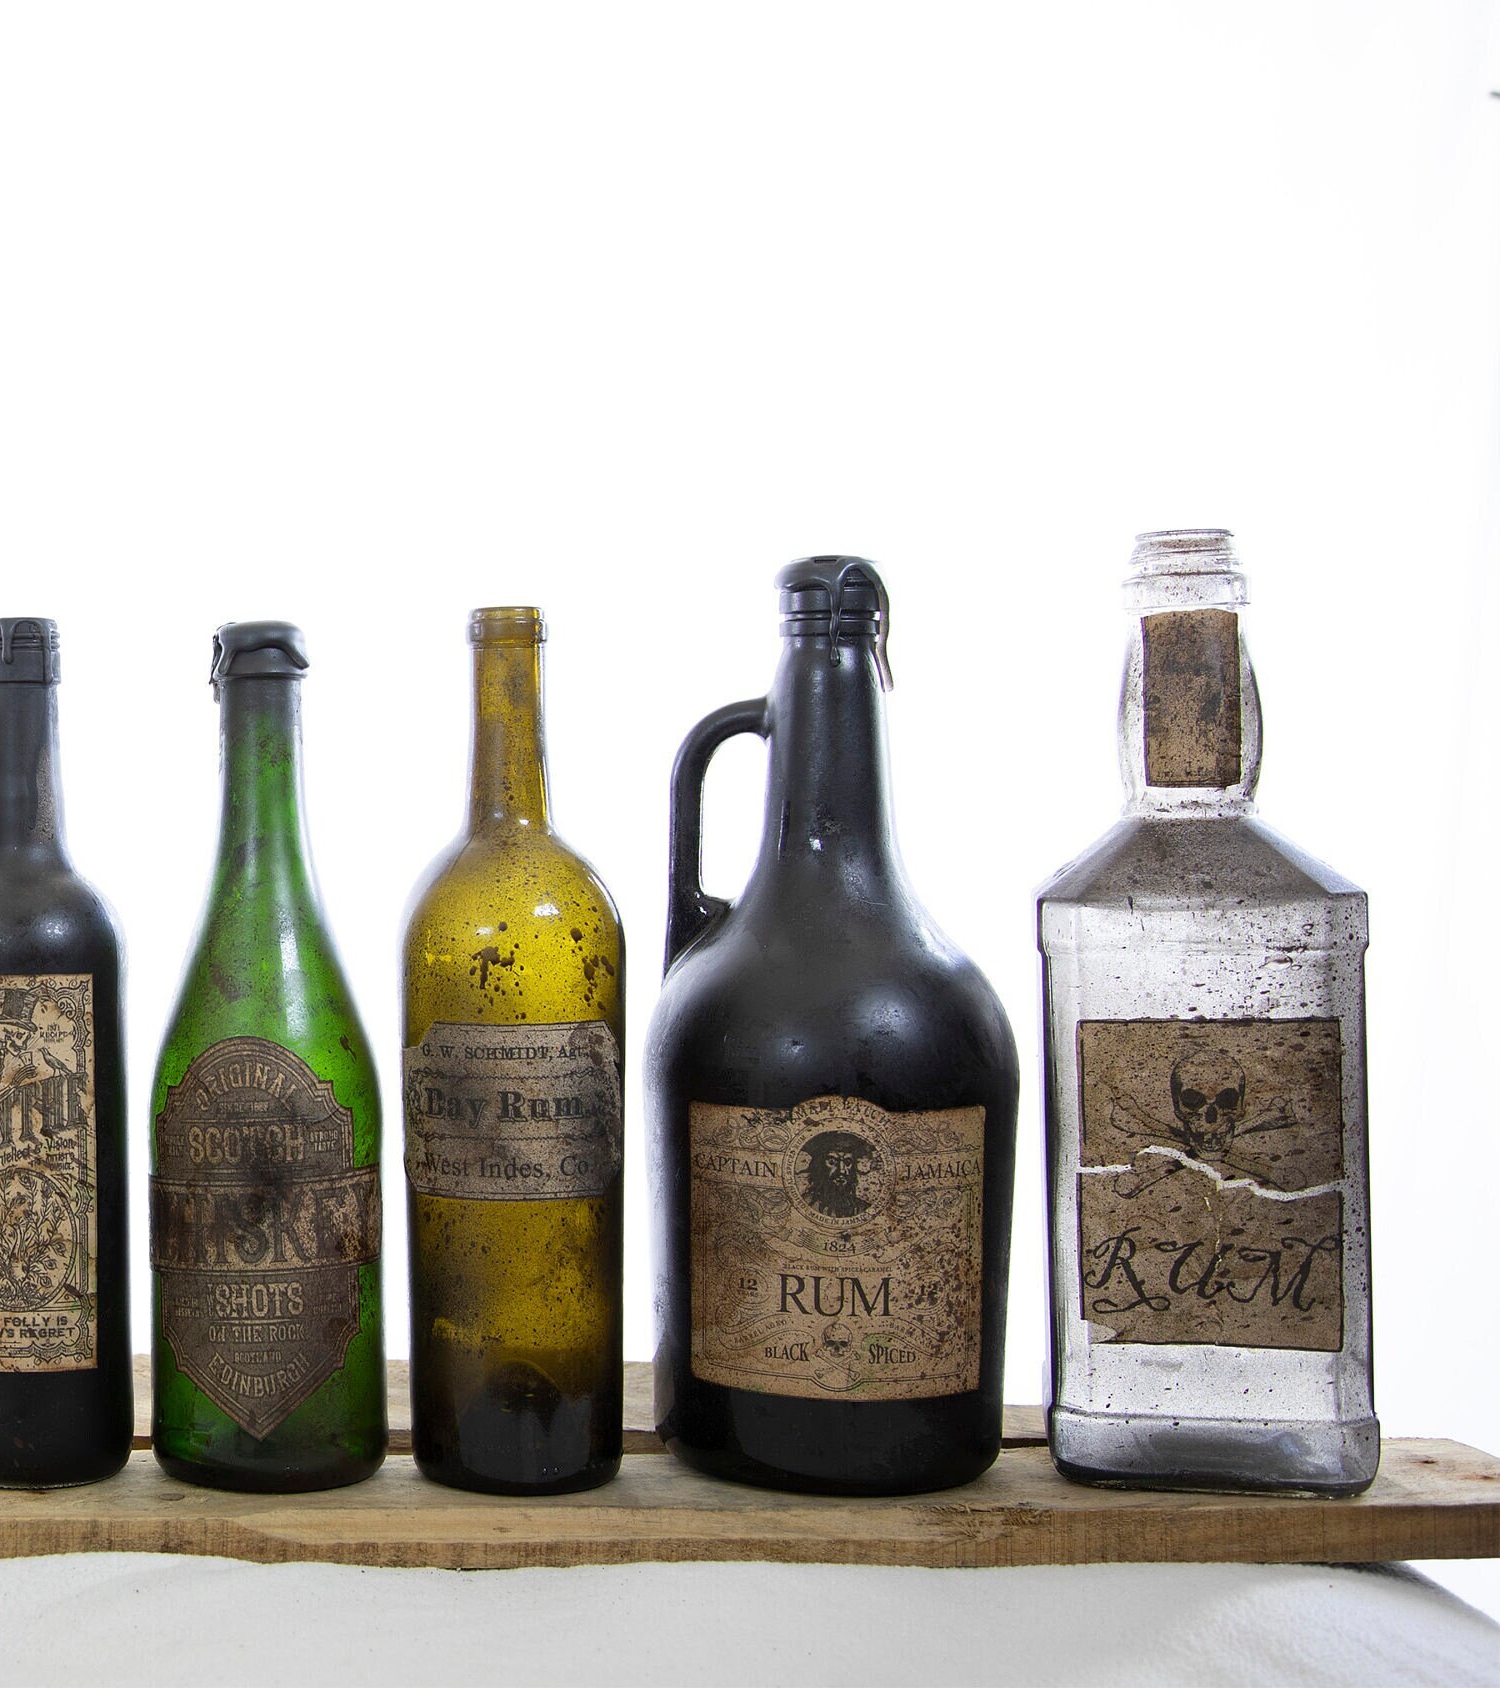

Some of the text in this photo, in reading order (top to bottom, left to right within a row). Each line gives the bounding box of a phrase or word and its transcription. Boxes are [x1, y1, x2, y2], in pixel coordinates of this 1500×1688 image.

[465, 1046, 553, 1061] SCHMIDT,
[195, 1061, 298, 1112] ORIGINAL
[425, 1087, 487, 1129] Bay
[188, 1124, 306, 1164] SCOTCH
[424, 1153, 470, 1176] West
[479, 1157, 551, 1179] Indes,
[694, 1154, 981, 1181] CAPTAIN JAMAICA
[830, 1217, 839, 1225] IN
[823, 1241, 856, 1254] 1824
[739, 1278, 758, 1291] 12
[777, 1273, 896, 1317] RUM
[216, 1282, 304, 1319] SHOTS
[4, 1316, 50, 1327] FOLLY
[57, 1316, 68, 1325] IS
[20, 1327, 75, 1338] REGRET
[209, 1327, 226, 1342] ON
[233, 1325, 262, 1343] THE
[765, 1344, 810, 1362] BLACK
[868, 1343, 917, 1364] SPICED
[207, 1352, 312, 1397] EDINBURGH
